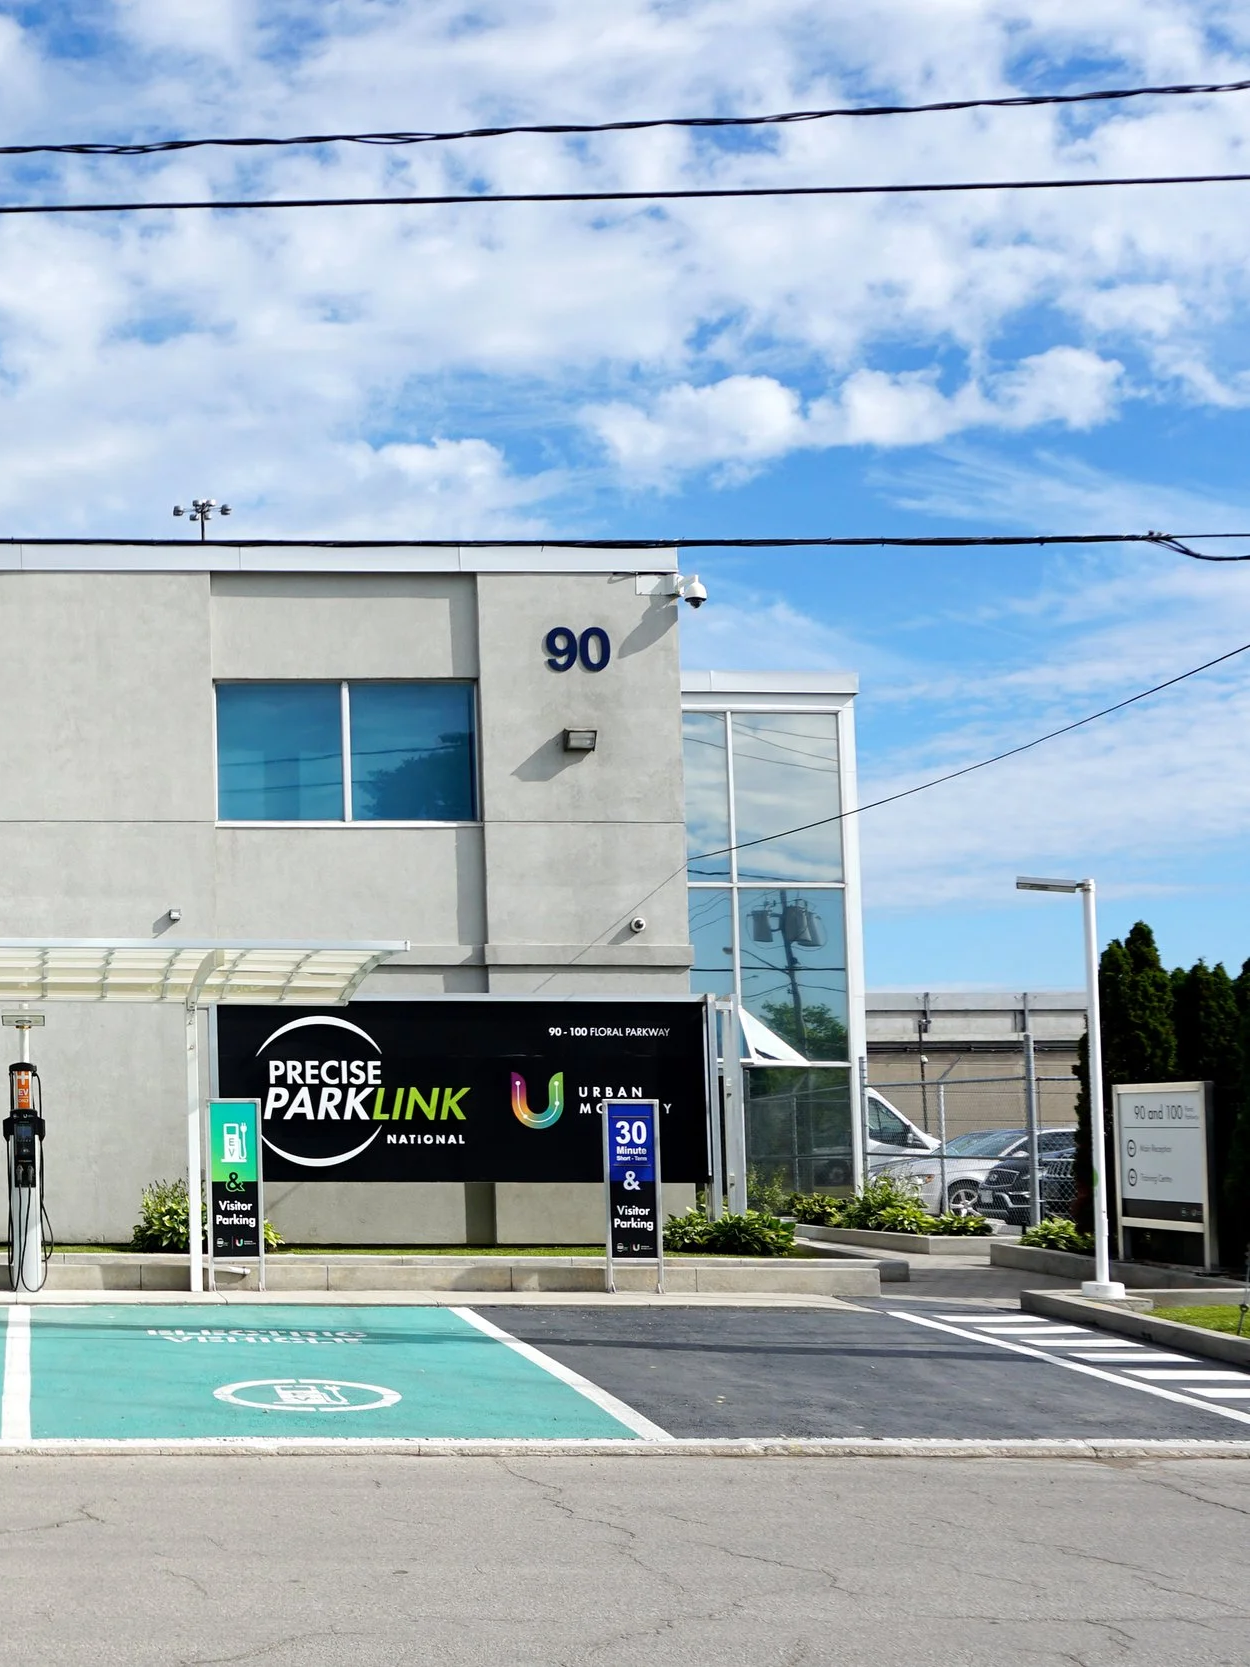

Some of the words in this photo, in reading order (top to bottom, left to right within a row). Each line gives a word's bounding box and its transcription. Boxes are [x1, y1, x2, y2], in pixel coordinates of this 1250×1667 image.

[545, 626, 611, 672] 90
[548, 1027, 562, 1037] 90
[569, 1027, 588, 1037] 100
[589, 1027, 624, 1037] FLORAL
[625, 1027, 671, 1037] PARKWAY
[268, 1060, 382, 1085] PRECISE
[18, 1088, 29, 1096] EV
[578, 1086, 643, 1098] URBAN
[263, 1086, 472, 1121] PARKLINK
[1134, 1105, 1145, 1120] 90
[1148, 1104, 1163, 1120] and
[1166, 1105, 1183, 1120] 100
[386, 1134, 466, 1145] NATIONAL
[615, 1121, 647, 1145] 30
[616, 1146, 646, 1155] Minute
[225, 1172, 246, 1192] &
[623, 1171, 641, 1190] &
[219, 1201, 252, 1211] Visitor
[616, 1205, 650, 1216] Visitor
[216, 1214, 256, 1228] Parking
[614, 1218, 654, 1231] Parking
[147, 1329, 368, 1337] ELECTRIC
